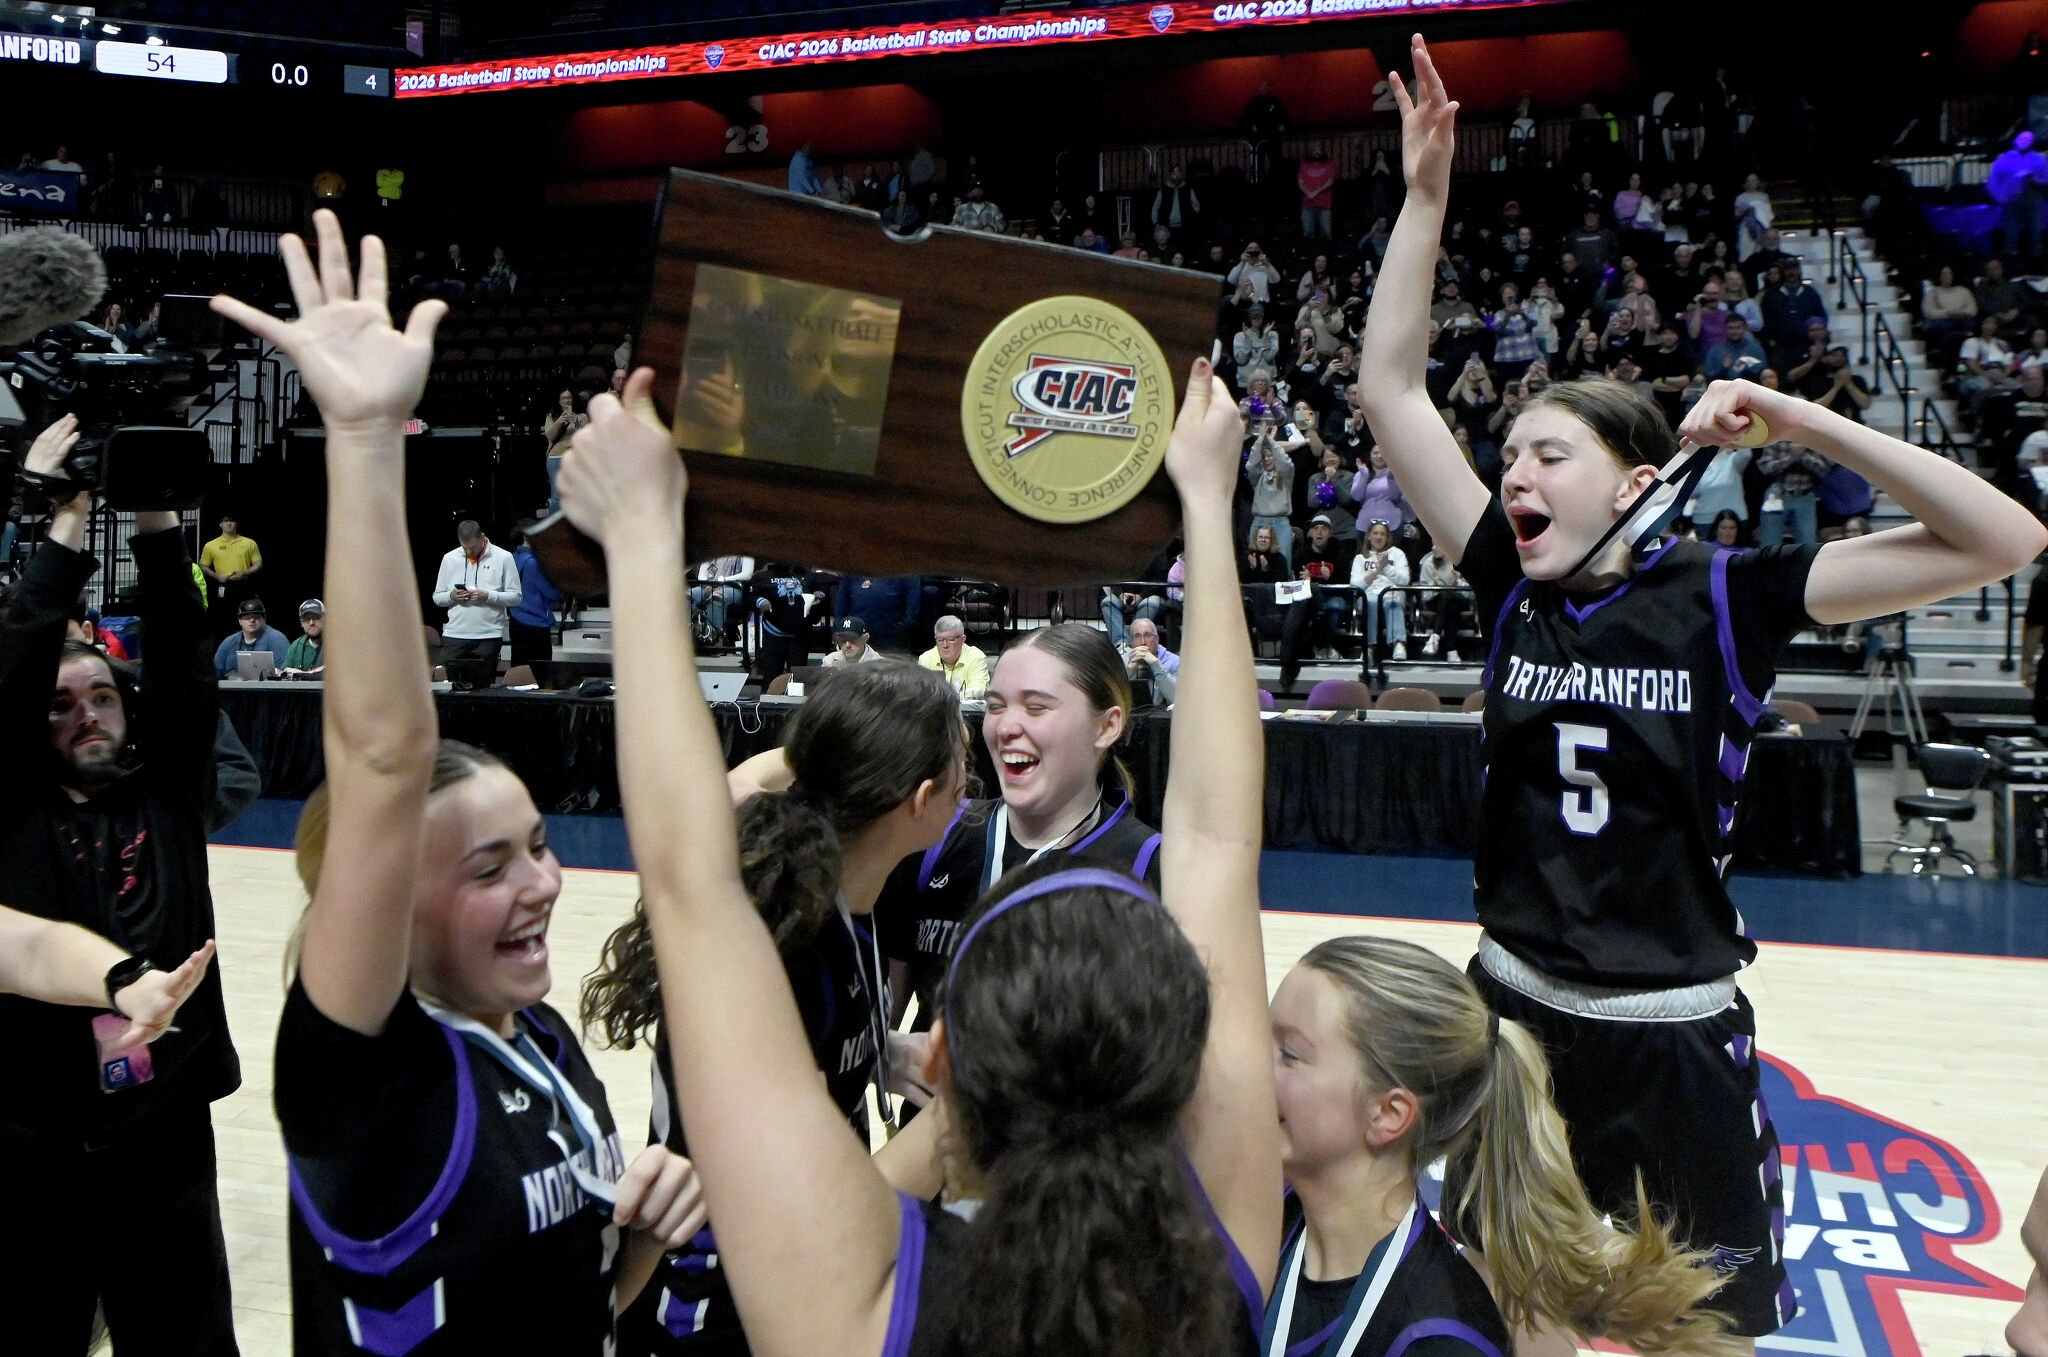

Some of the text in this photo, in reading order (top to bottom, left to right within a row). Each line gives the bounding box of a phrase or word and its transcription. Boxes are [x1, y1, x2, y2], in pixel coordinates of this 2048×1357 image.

[1213, 3, 1259, 22] CIAC
[1259, 0, 1308, 18] 2026
[758, 16, 1106, 61] CIAC 2026 Basketball State Championships
[146, 53, 176, 73] 54
[271, 63, 309, 86] 0.0
[365, 74, 377, 90] 4
[399, 55, 667, 90] 2026 Basketball State Championships
[725, 125, 769, 154] 23
[981, 312, 1119, 396] INTERSCHOLASTIC
[1034, 369, 1137, 414] CIAC
[979, 401, 1057, 507] CONNECTICUT
[1068, 420, 1158, 507] CONFERENCE
[1555, 661, 1692, 712] BRANFORD
[1552, 722, 1609, 834] 5
